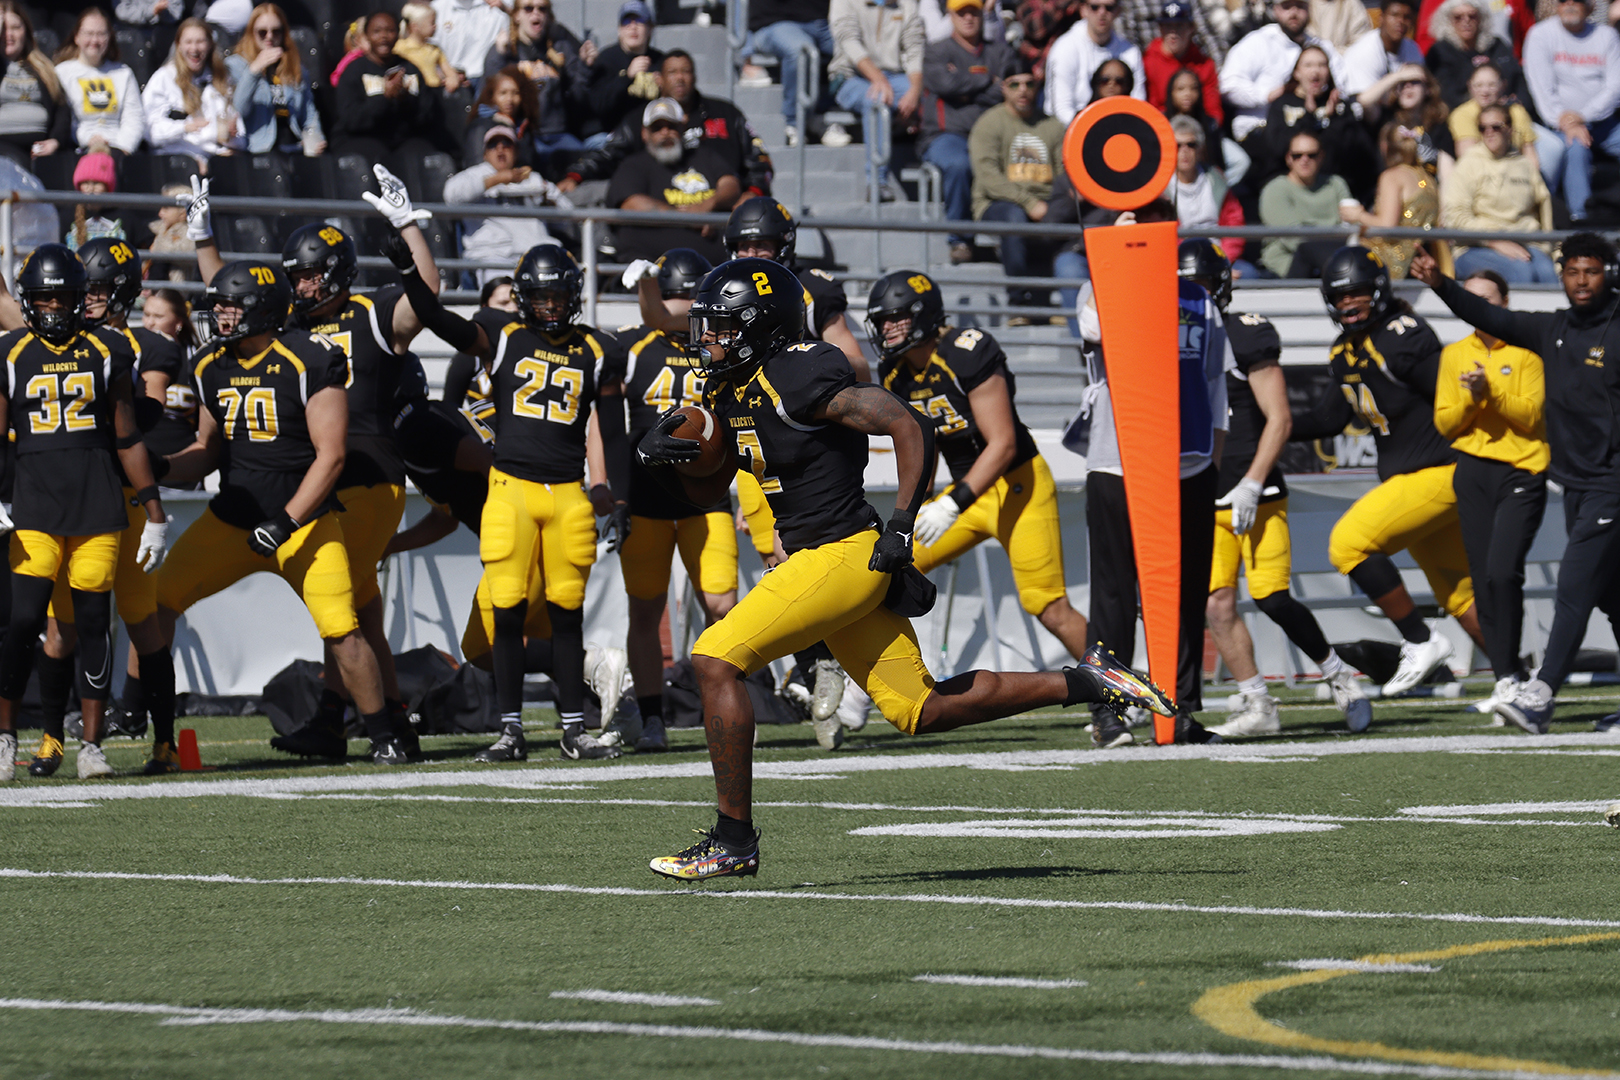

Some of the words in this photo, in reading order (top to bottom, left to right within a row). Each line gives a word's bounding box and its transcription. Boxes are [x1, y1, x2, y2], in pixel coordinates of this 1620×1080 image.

[109, 242, 134, 265] 24
[248, 266, 277, 286] 70
[752, 271, 773, 296] 2
[42, 361, 79, 374] WILDCATS
[533, 348, 569, 366] WILDCATS
[229, 376, 261, 387] WILDCATS
[512, 356, 584, 425] 23
[25, 371, 97, 434] 32
[216, 387, 280, 442] 70
[736, 429, 784, 494] 2
